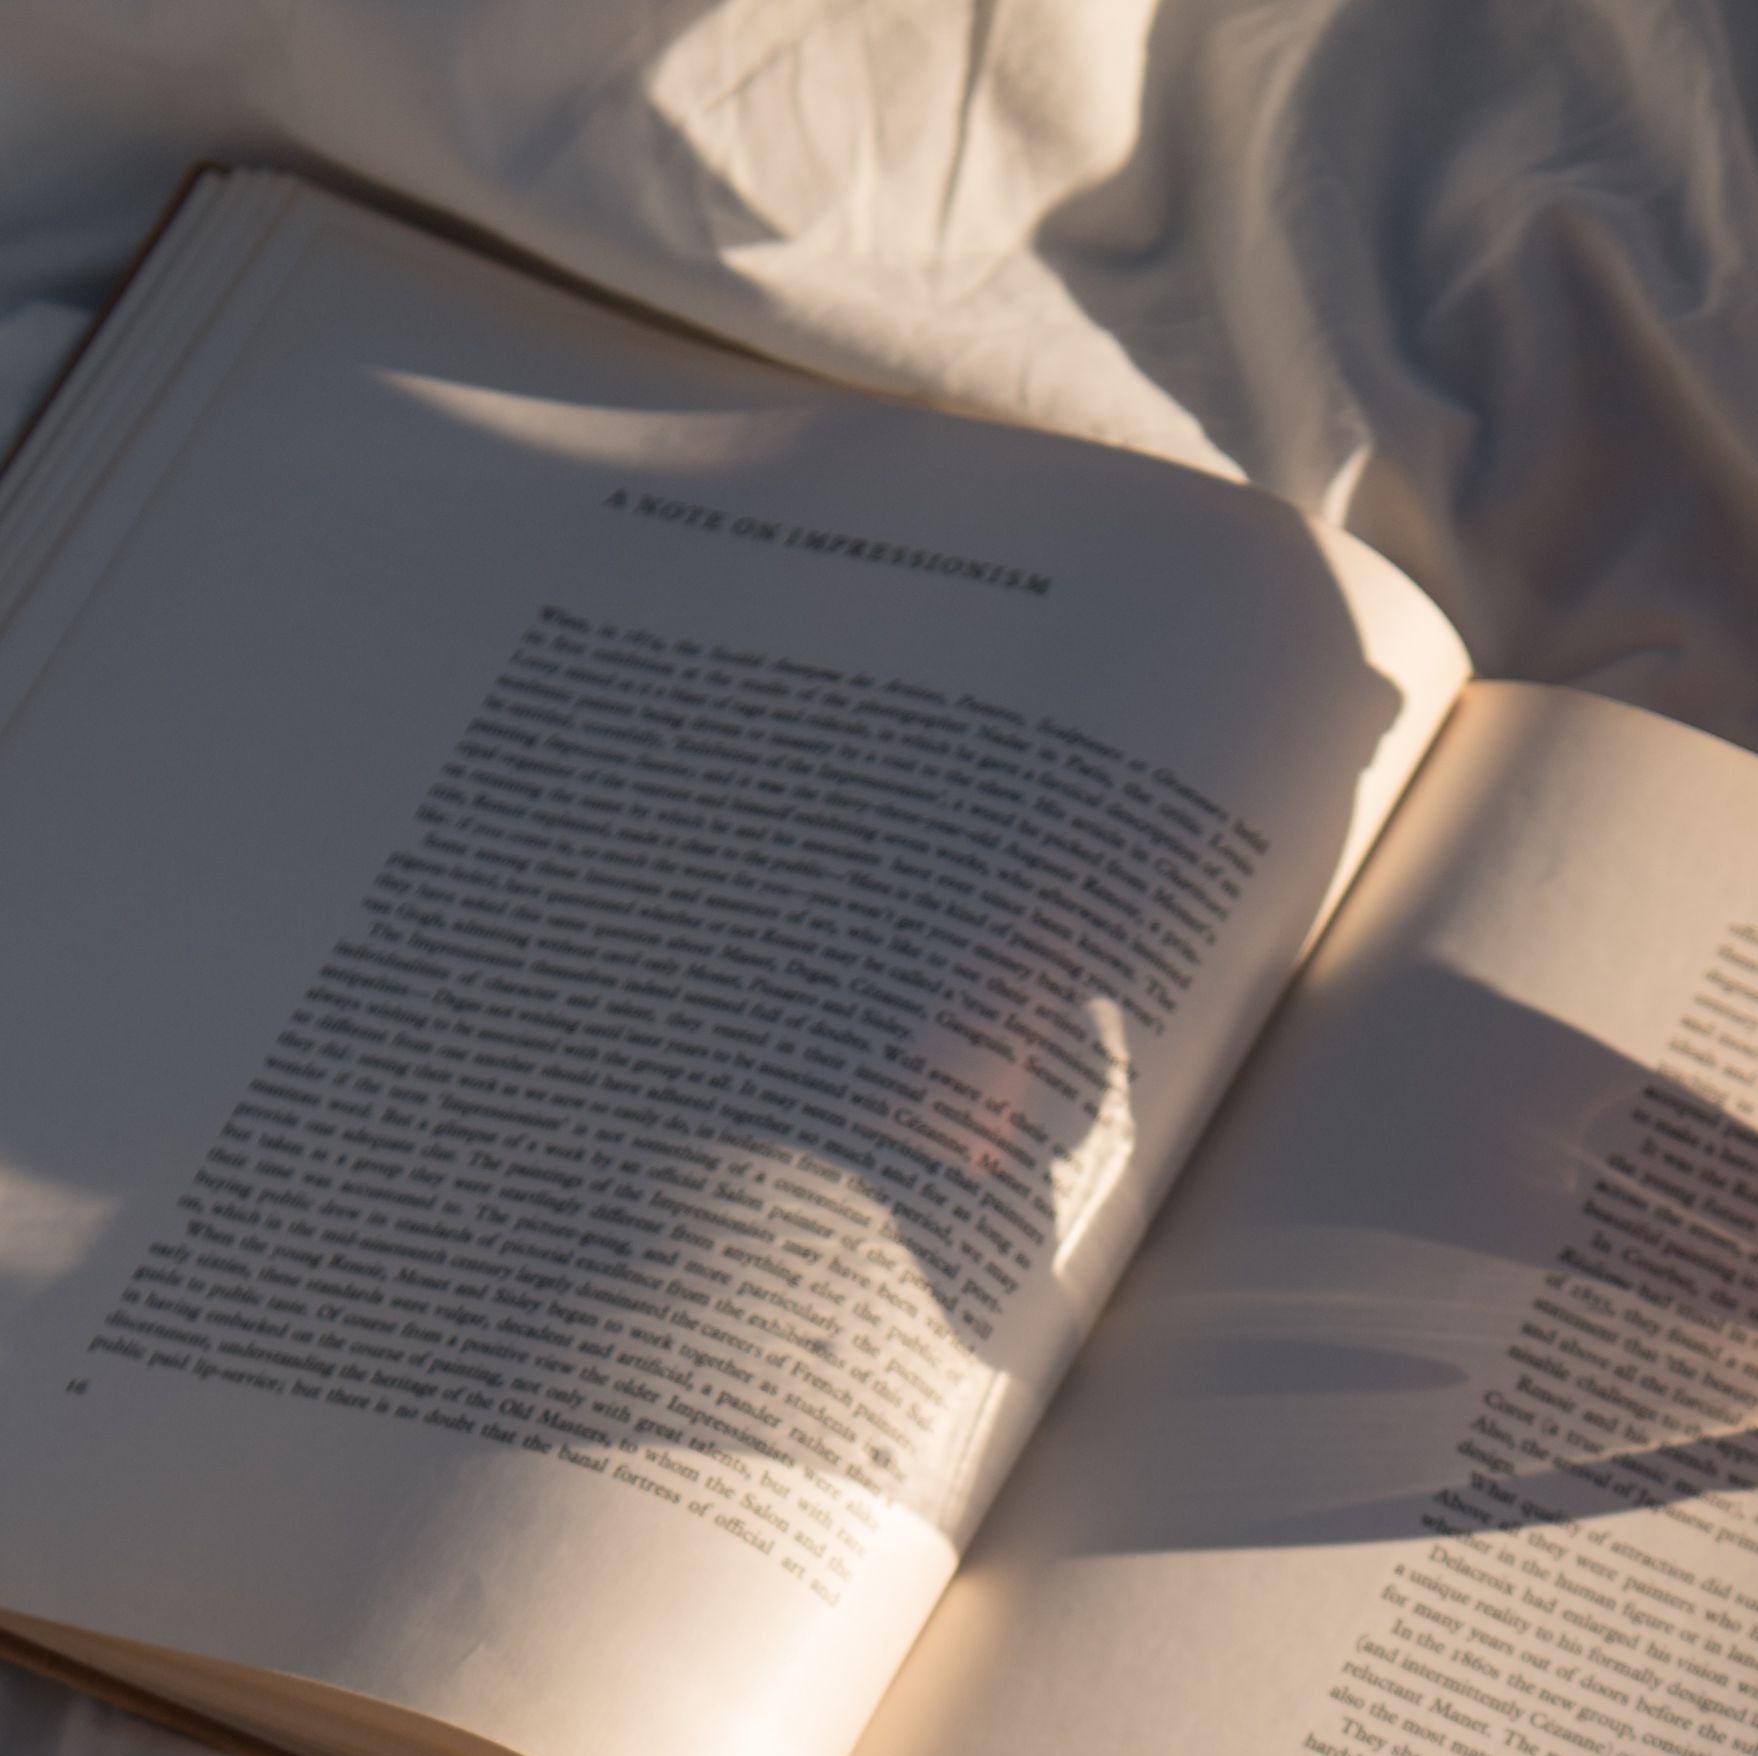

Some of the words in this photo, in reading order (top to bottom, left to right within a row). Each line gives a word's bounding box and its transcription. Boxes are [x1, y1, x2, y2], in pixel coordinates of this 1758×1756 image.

[604, 487, 629, 508] A
[634, 492, 726, 533] NOTE
[729, 513, 782, 542] ON
[783, 526, 1052, 597] IMPRESSIONISM
[86, 1333, 147, 1361] public
[146, 1350, 192, 1372] paid
[290, 1377, 323, 1401] but
[325, 1386, 372, 1411] there
[372, 1396, 391, 1415] is
[393, 1404, 420, 1421] no
[422, 1407, 477, 1435] doubt
[479, 1421, 518, 1446] that
[520, 1433, 553, 1455] the
[557, 1442, 610, 1474] banal
[611, 1463, 683, 1505] fortress
[687, 1500, 715, 1519] of
[712, 1513, 777, 1557] official
[779, 1556, 807, 1582] art
[808, 1577, 842, 1609] and
[217, 1340, 337, 1380] understanding
[338, 1363, 369, 1383] the
[369, 1368, 440, 1399] heritage
[441, 1386, 468, 1403] of
[463, 1390, 495, 1411] the
[498, 1398, 536, 1422] Old
[618, 1436, 639, 1454] to
[644, 1448, 701, 1483] whom
[703, 1475, 736, 1501] the
[738, 1492, 791, 1534] Salon
[792, 1529, 828, 1560] and
[825, 1555, 854, 1584] the
[1389, 1616, 1414, 1642] In
[1414, 1632, 1447, 1656] the
[1449, 1648, 1502, 1681] 1860s
[1505, 1672, 1537, 1696] the
[1537, 1687, 1577, 1712] new
[1575, 1706, 1637, 1742] group,
[1427, 1544, 1517, 1598] Delacroix
[1520, 1585, 1559, 1615] had
[1560, 1608, 1642, 1651] enlarged
[1644, 1640, 1673, 1665] his
[1675, 1657, 1730, 1689] vision
[1340, 1715, 1387, 1753] They
